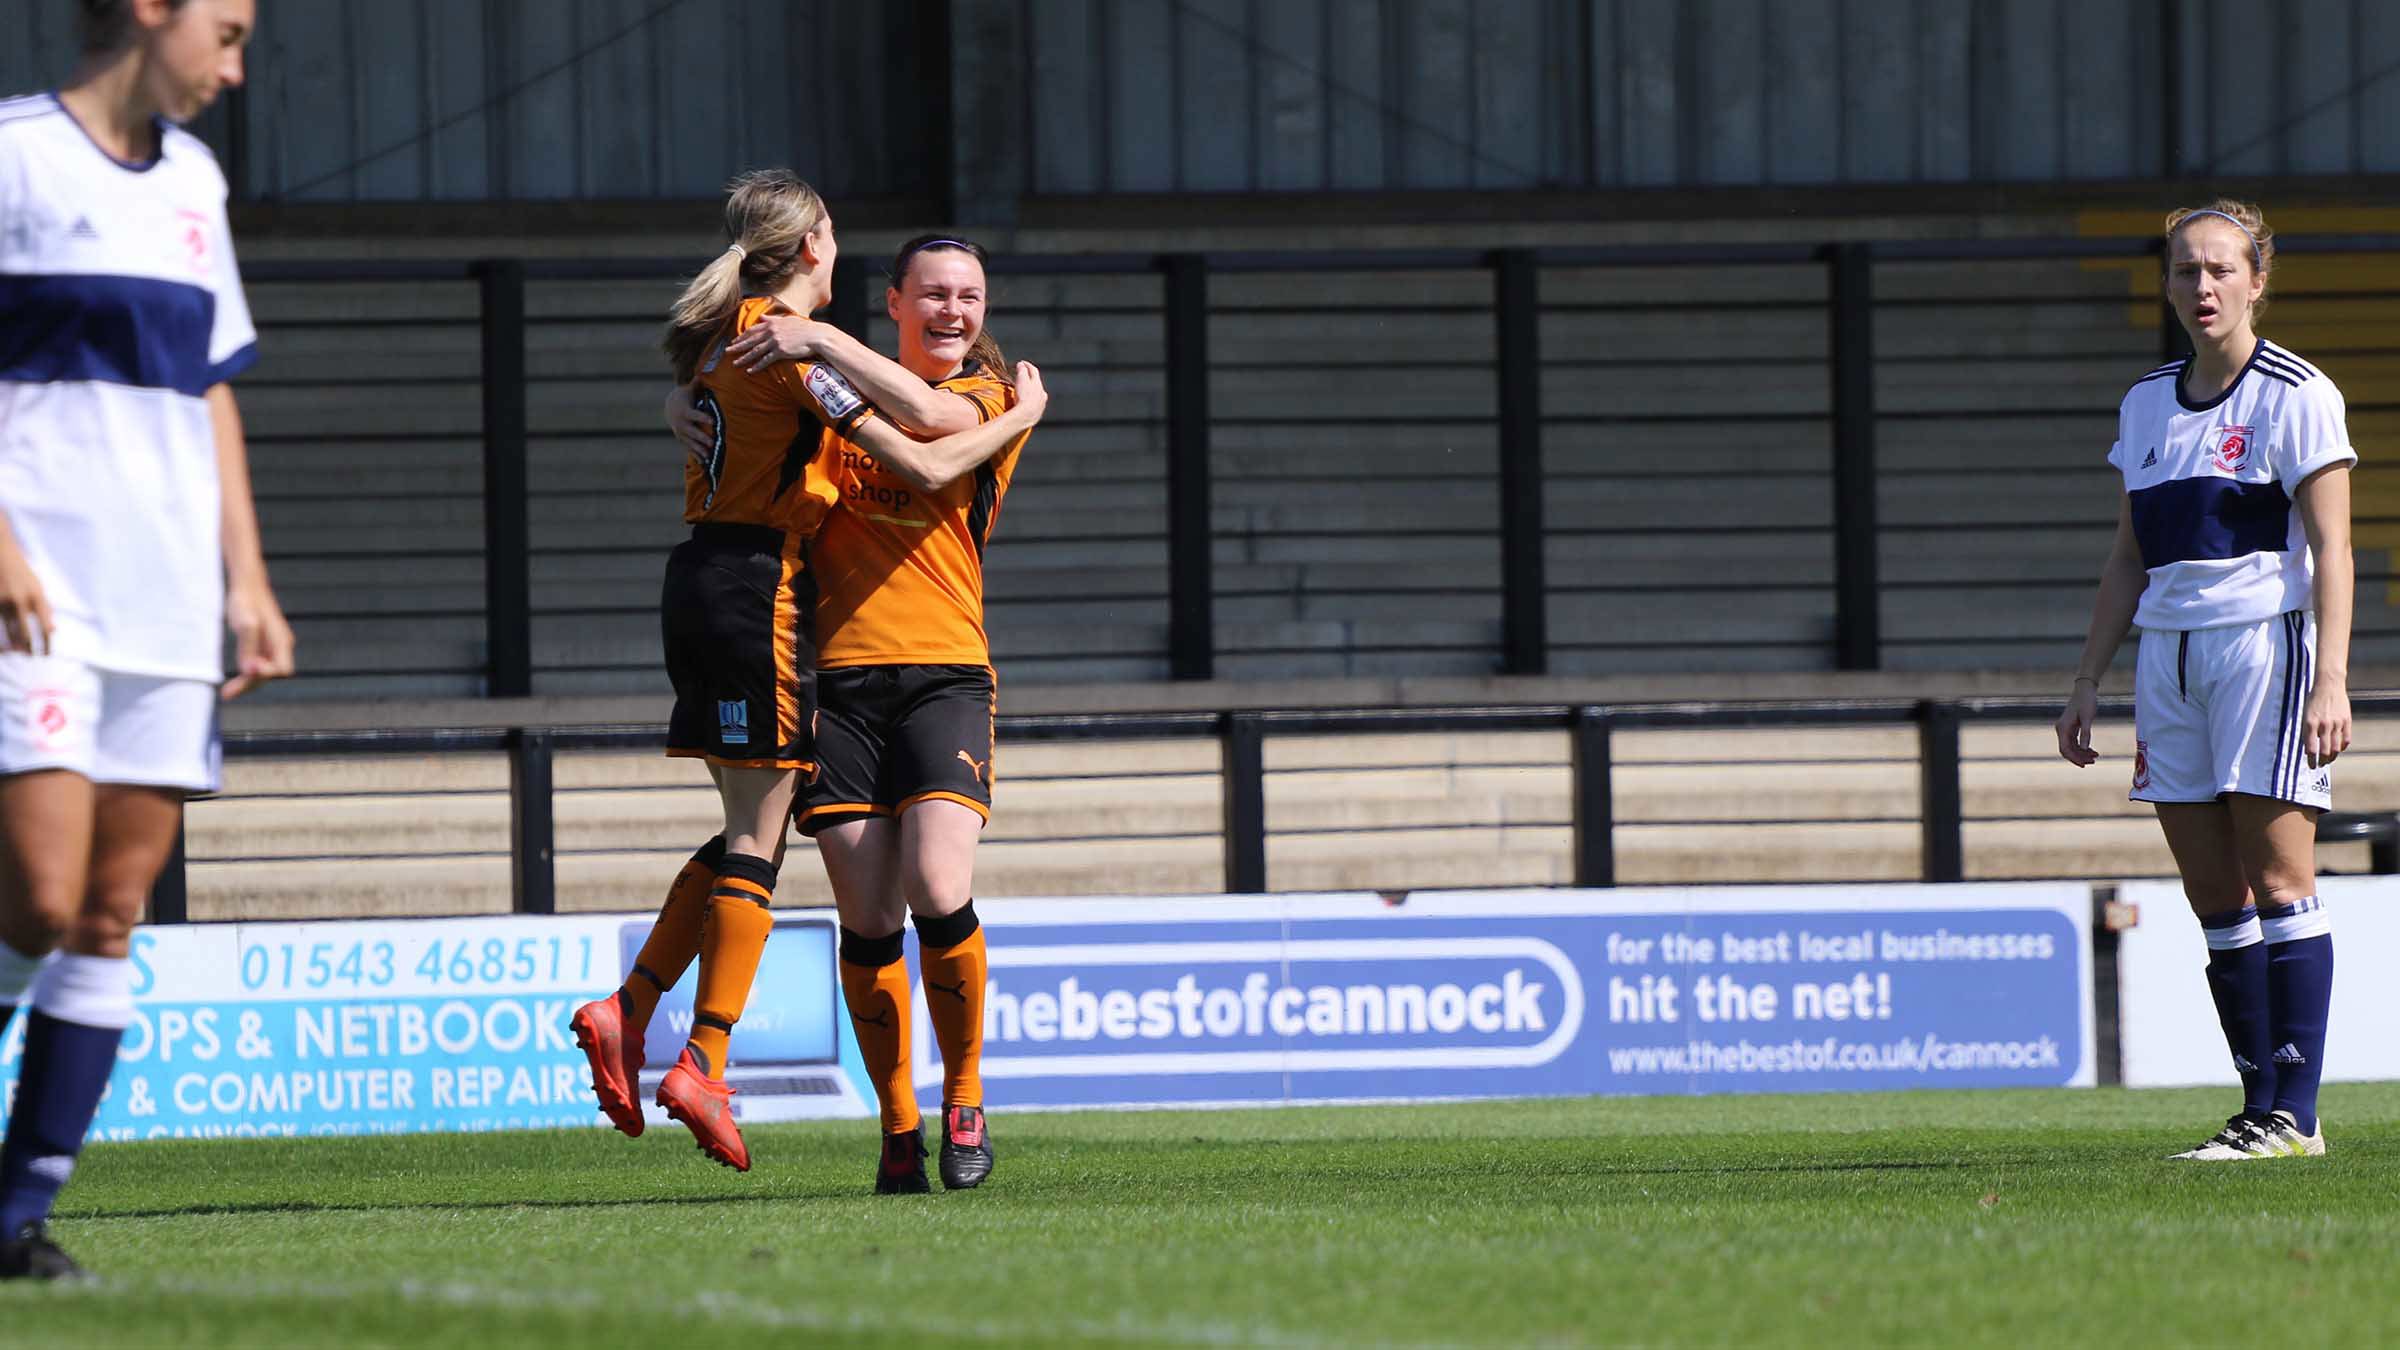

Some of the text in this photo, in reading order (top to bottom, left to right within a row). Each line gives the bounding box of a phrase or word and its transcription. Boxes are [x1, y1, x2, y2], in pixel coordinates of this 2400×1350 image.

[849, 480, 911, 512] shop
[241, 935, 593, 991] 01543 468511
[1606, 928, 2055, 964] for the best local businesses
[983, 967, 1548, 1042] hebestofcannock
[1608, 972, 1893, 1023] hit the net!
[235, 1009, 273, 1060] &
[1608, 1032, 2061, 1074] www.thebestof.co.uk/cannock
[128, 1076, 158, 1117] &
[173, 1068, 416, 1116] COMPUTER
